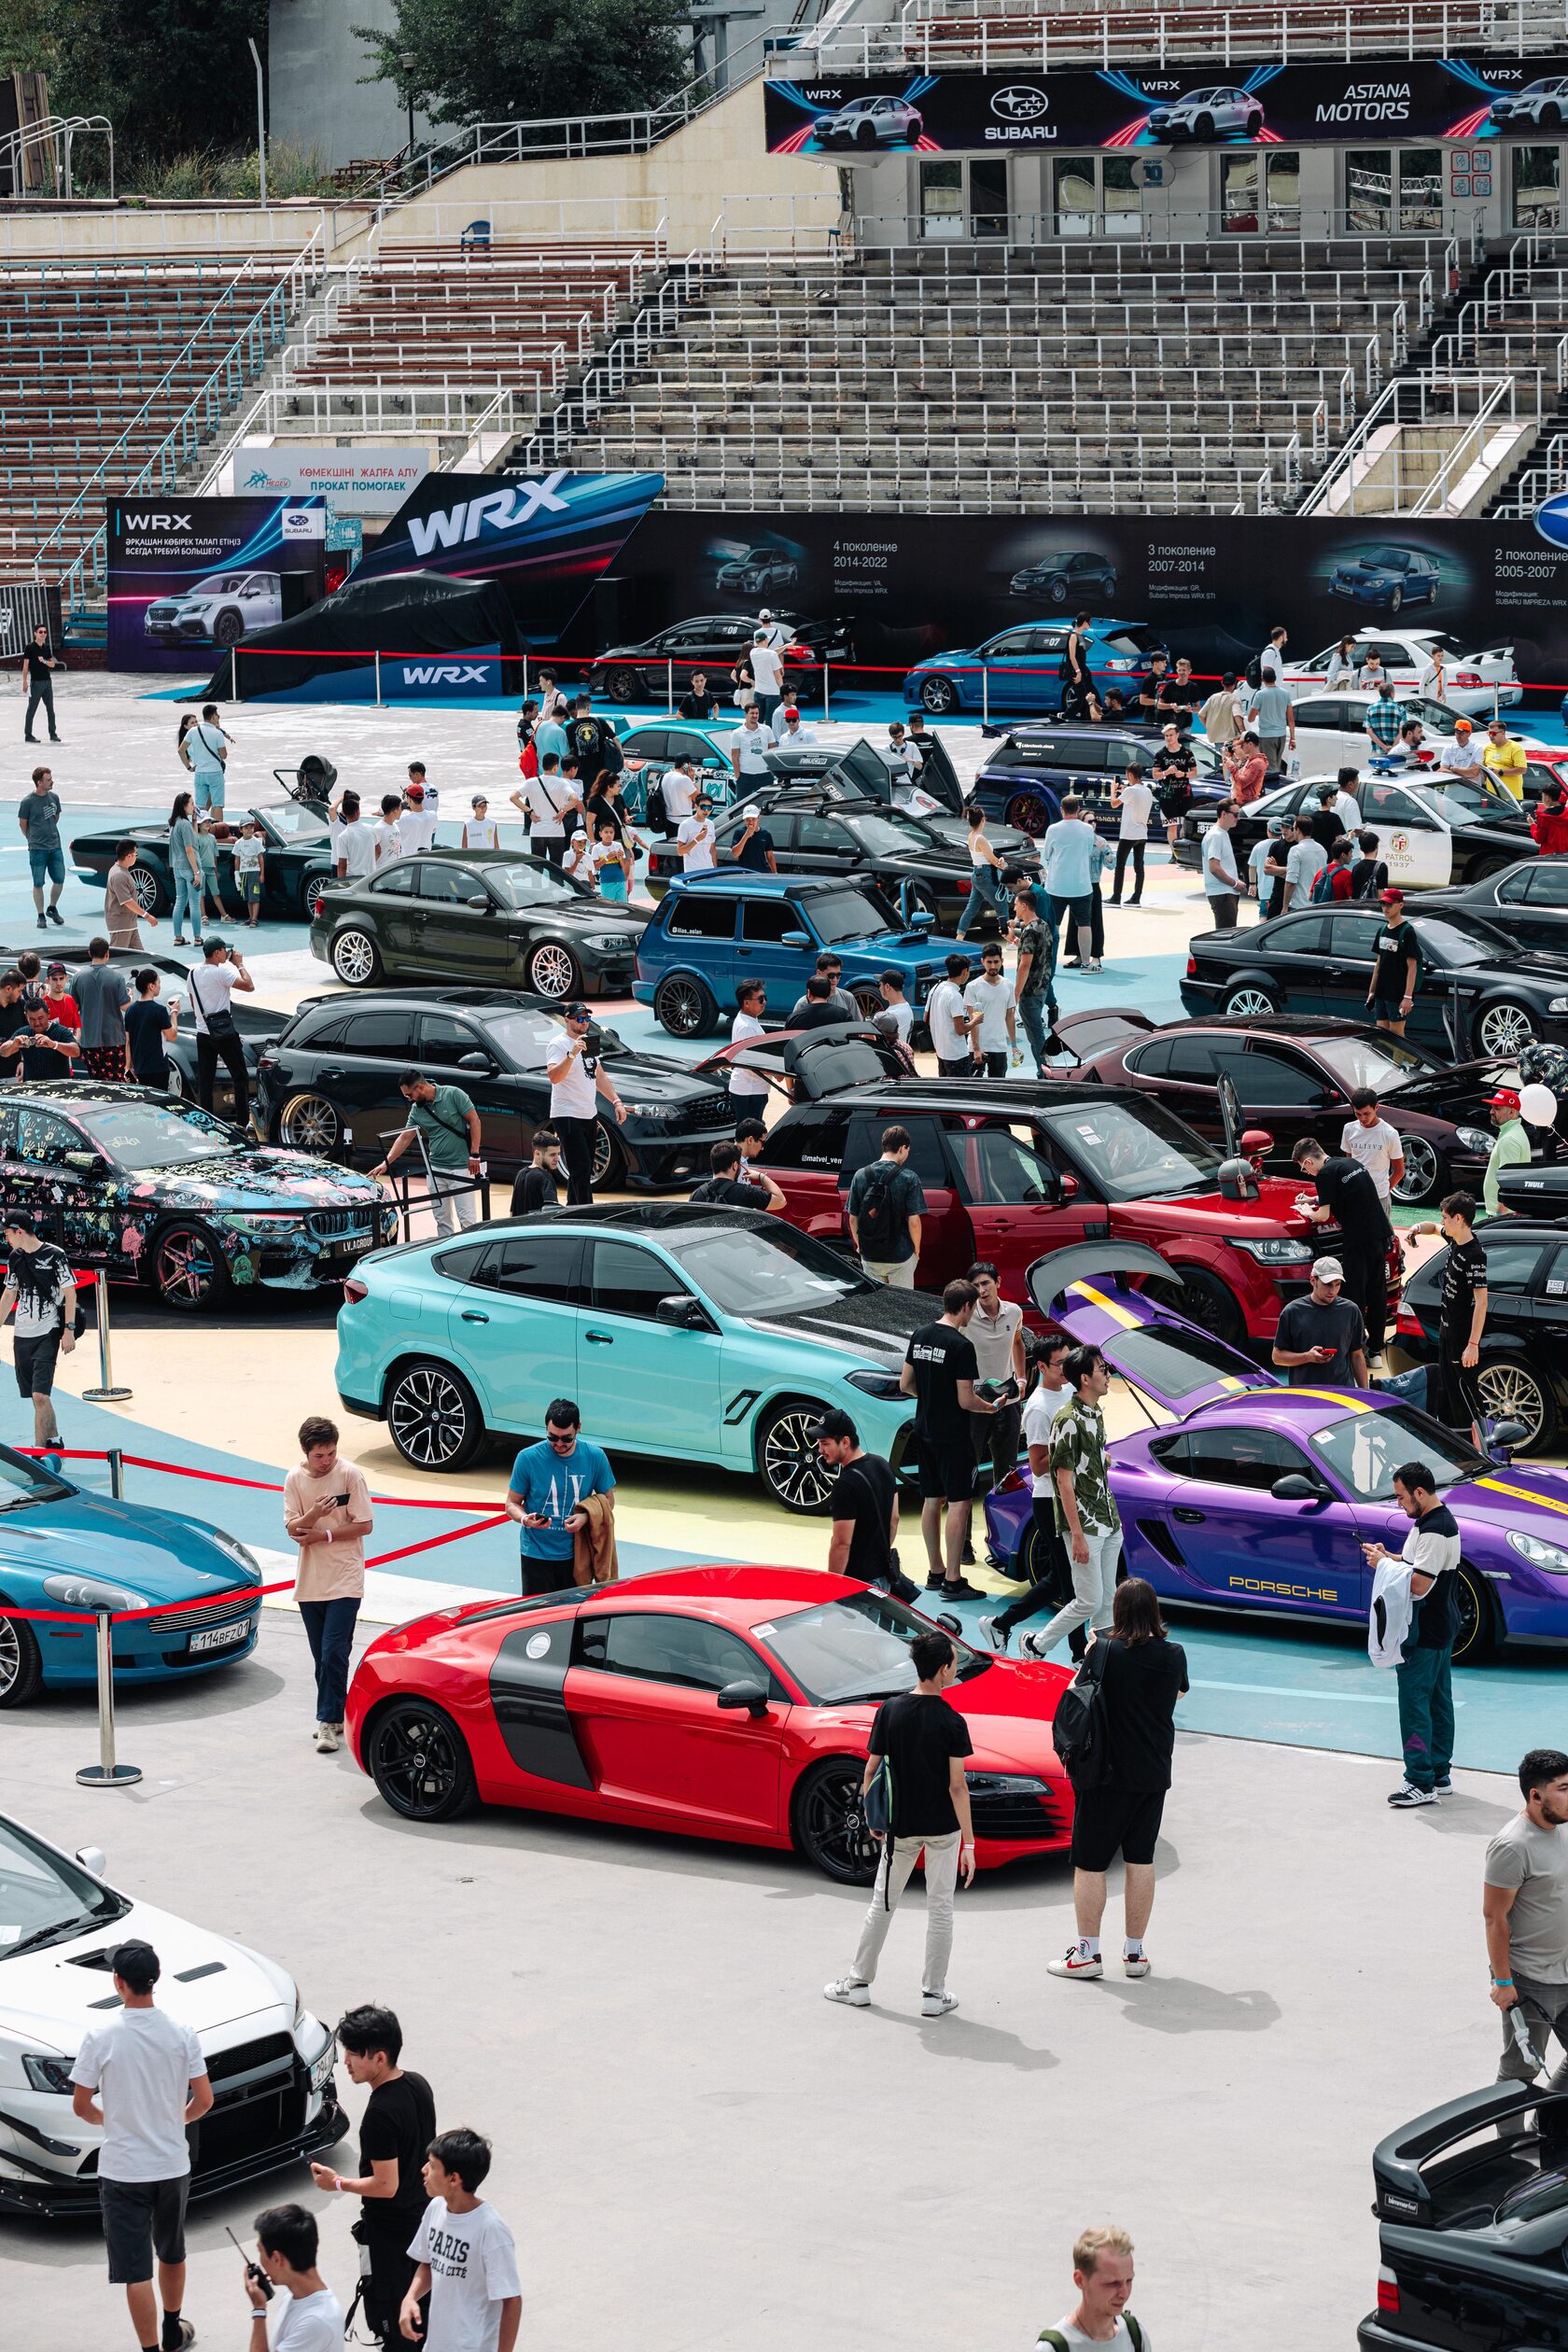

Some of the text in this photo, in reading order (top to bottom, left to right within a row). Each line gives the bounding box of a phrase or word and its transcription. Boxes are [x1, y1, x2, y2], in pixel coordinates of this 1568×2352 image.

[1482, 70, 1522, 80] WRX
[1141, 80, 1181, 91] WRX
[1344, 83, 1410, 99] ASTANA
[805, 90, 842, 100] WRX
[1315, 101, 1410, 122] MOTORS
[985, 126, 1057, 140] SUBARU
[300, 468, 418, 477] КӨМЕКШІНІ ЖАЛҒА АЛУ
[311, 482, 349, 491] ПРОКАТ
[407, 469, 570, 556] WRX
[125, 515, 192, 529] WRX
[154, 547, 180, 555] ТРЕБУЙ
[833, 540, 898, 552] 4 поколение
[1148, 544, 1216, 555] 3 поколение
[1495, 549, 1568, 561] 2 поколение
[833, 556, 888, 567] 2014-2022
[1148, 561, 1205, 571] 2007-2014
[1495, 566, 1556, 578] 2005-2007
[402, 665, 490, 684] WRX
[1385, 853, 1415, 862] PATROL
[1229, 1576, 1337, 1602] PORSCHE
[428, 2227, 469, 2263] PARIS
